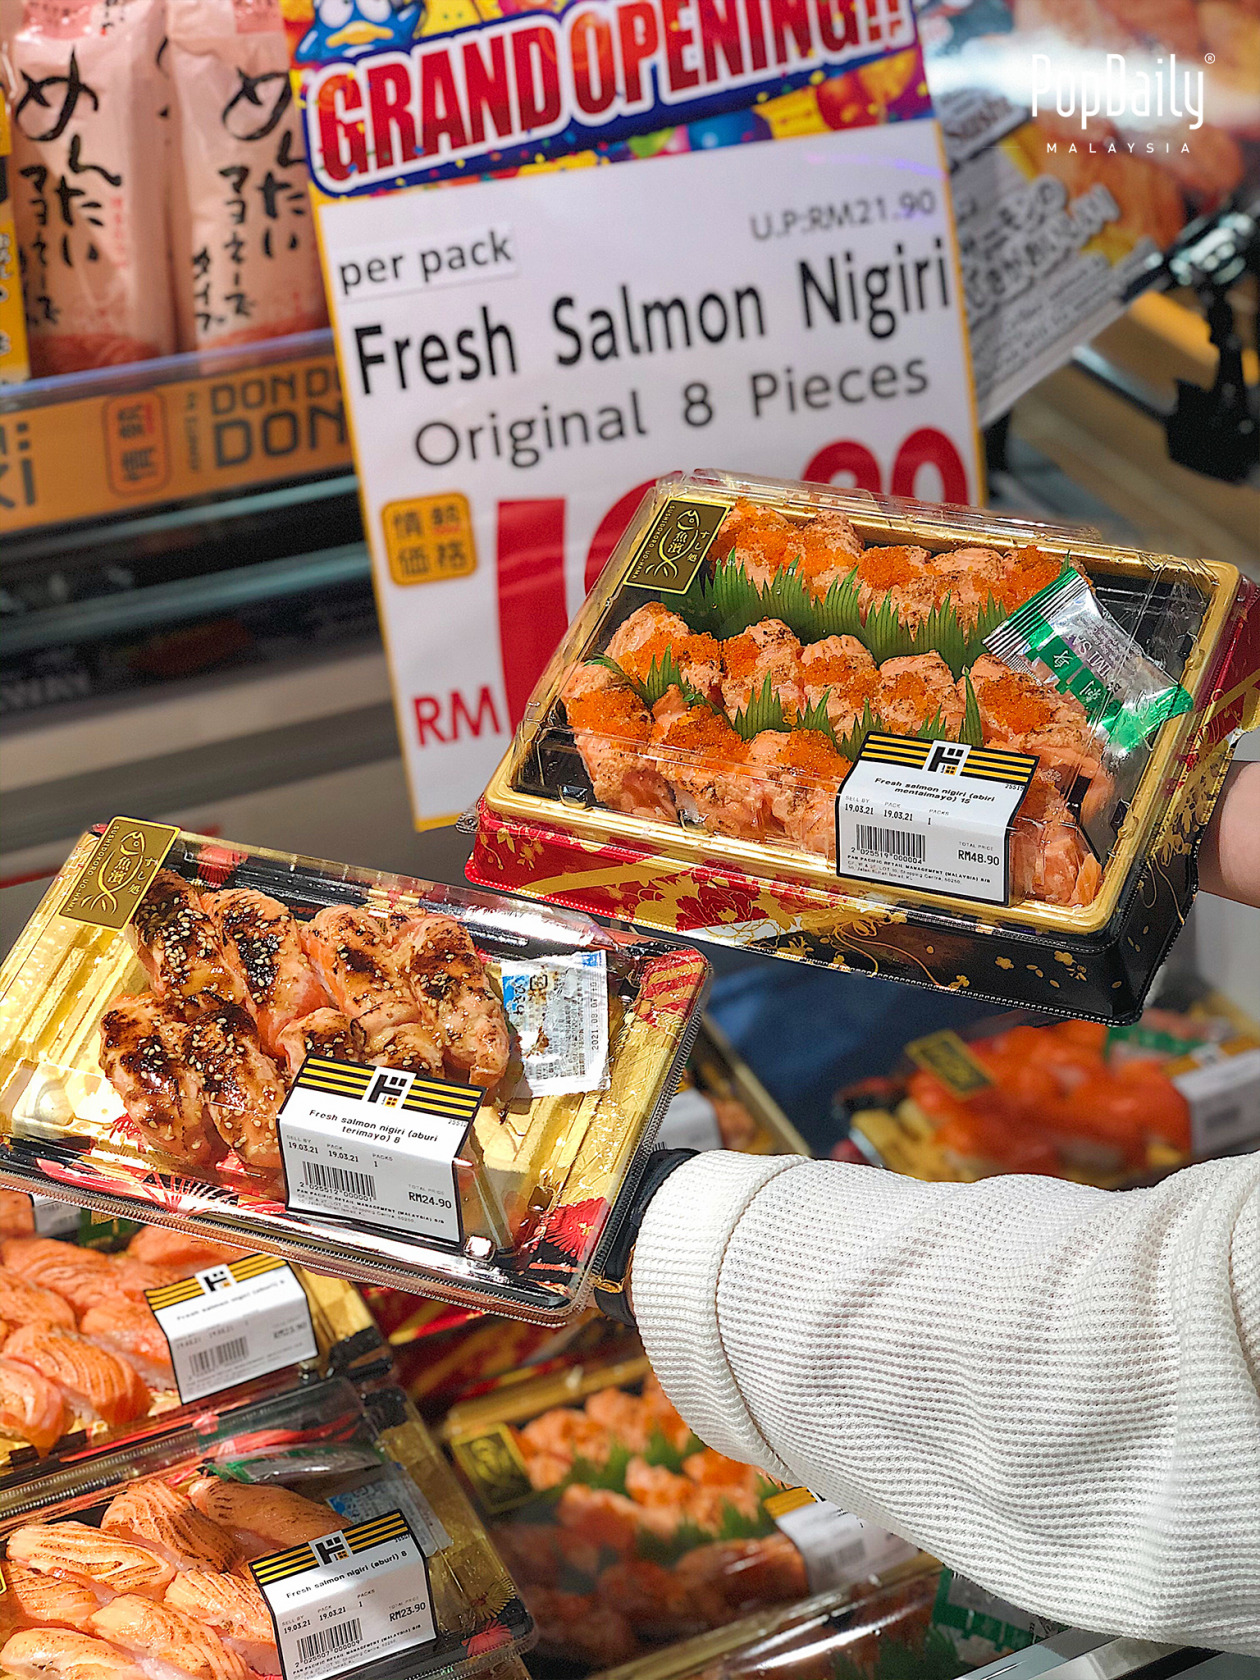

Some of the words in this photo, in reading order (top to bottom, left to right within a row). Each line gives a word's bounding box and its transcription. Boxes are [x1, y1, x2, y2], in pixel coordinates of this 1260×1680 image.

[315, 24, 563, 183] GRAND
[570, 0, 904, 115] OPENING!!
[339, 253, 405, 296] per
[420, 229, 513, 283] pack
[354, 304, 518, 395] Fresh
[552, 282, 765, 367] Salmon
[798, 237, 949, 339] Nigiri
[210, 374, 297, 416] DON
[415, 388, 647, 468] Original
[683, 382, 714, 428] 8
[751, 358, 928, 418] Pieces
[413, 685, 503, 749] RM
[875, 777, 902, 788] Fresh
[905, 783, 939, 793] salmon
[942, 788, 967, 798] nigiri
[844, 803, 874, 816] 19.03.21
[884, 810, 914, 822] 19.03.21
[958, 849, 1000, 866] RM48.90
[309, 1109, 338, 1121] Fresh
[341, 1116, 377, 1130] salmon
[379, 1124, 405, 1136] nigiri
[408, 1129, 438, 1142] (aburi
[342, 1126, 390, 1142] terimayo)
[288, 1141, 319, 1155] 19.03.21
[328, 1150, 359, 1163] 19.03.21
[408, 1191, 452, 1209] RM24.90
[286, 1586, 312, 1599] Fresh
[314, 1574, 346, 1590] salmon
[346, 1564, 369, 1578] nigiri
[370, 1553, 400, 1569] (aburi)
[319, 1606, 347, 1622] 19.03.21
[389, 1601, 427, 1622] RM23.90
[283, 1618, 312, 1635] 19.03.21
